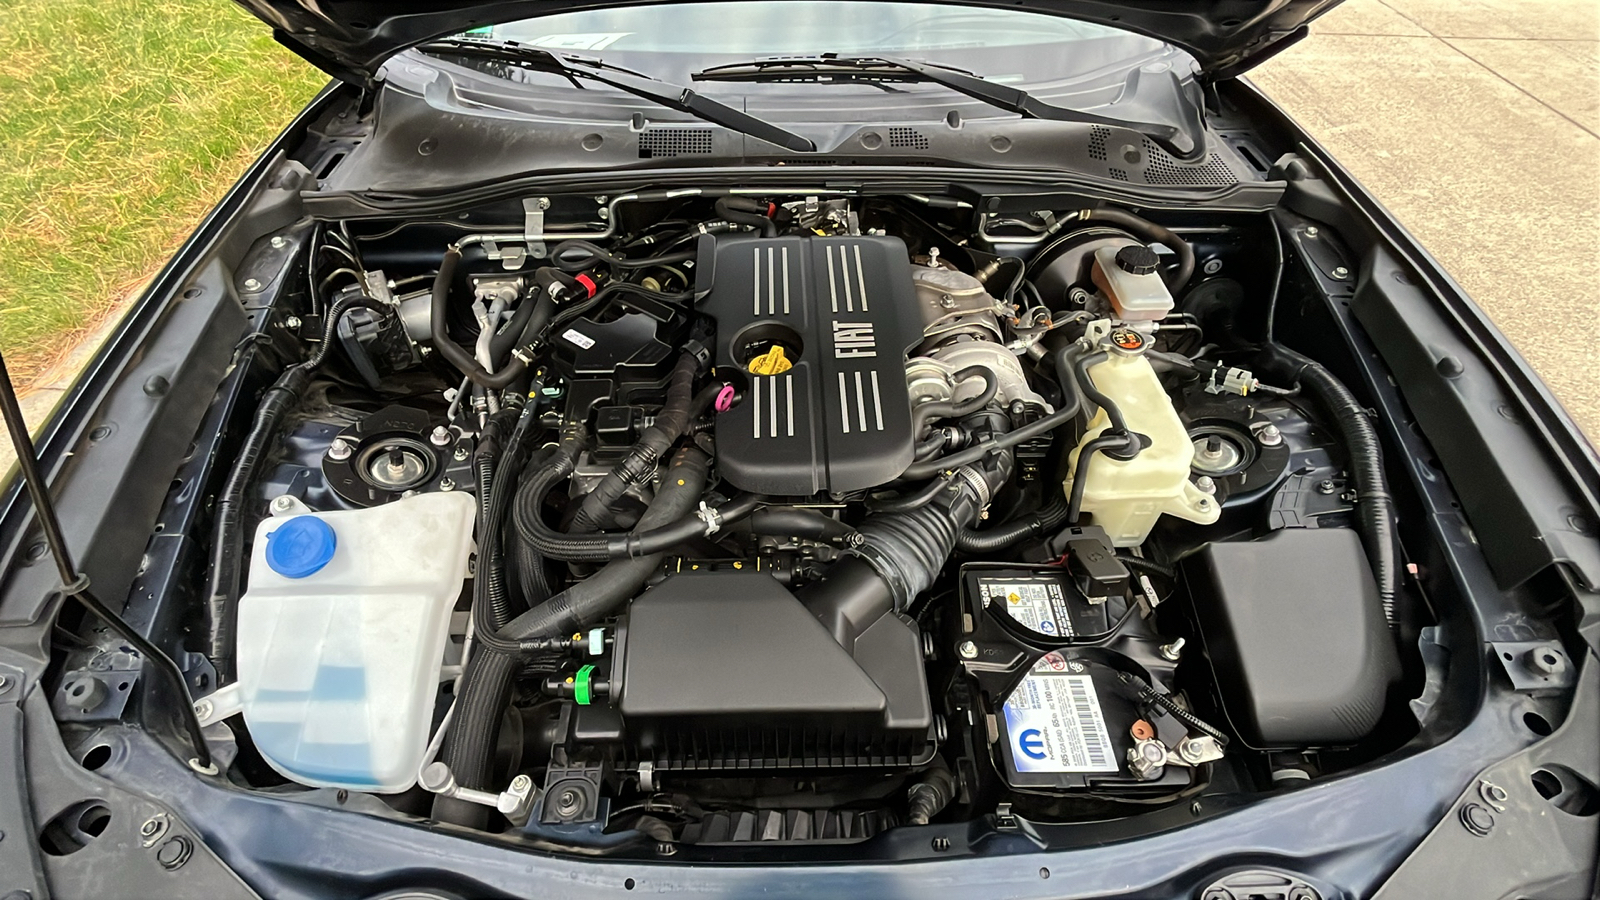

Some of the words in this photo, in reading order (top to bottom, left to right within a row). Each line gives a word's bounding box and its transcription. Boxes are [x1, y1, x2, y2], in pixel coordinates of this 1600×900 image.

[832, 320, 876, 358] FIAT
[1045, 691, 1054, 702] 100
[1060, 754, 1070, 766] 585
